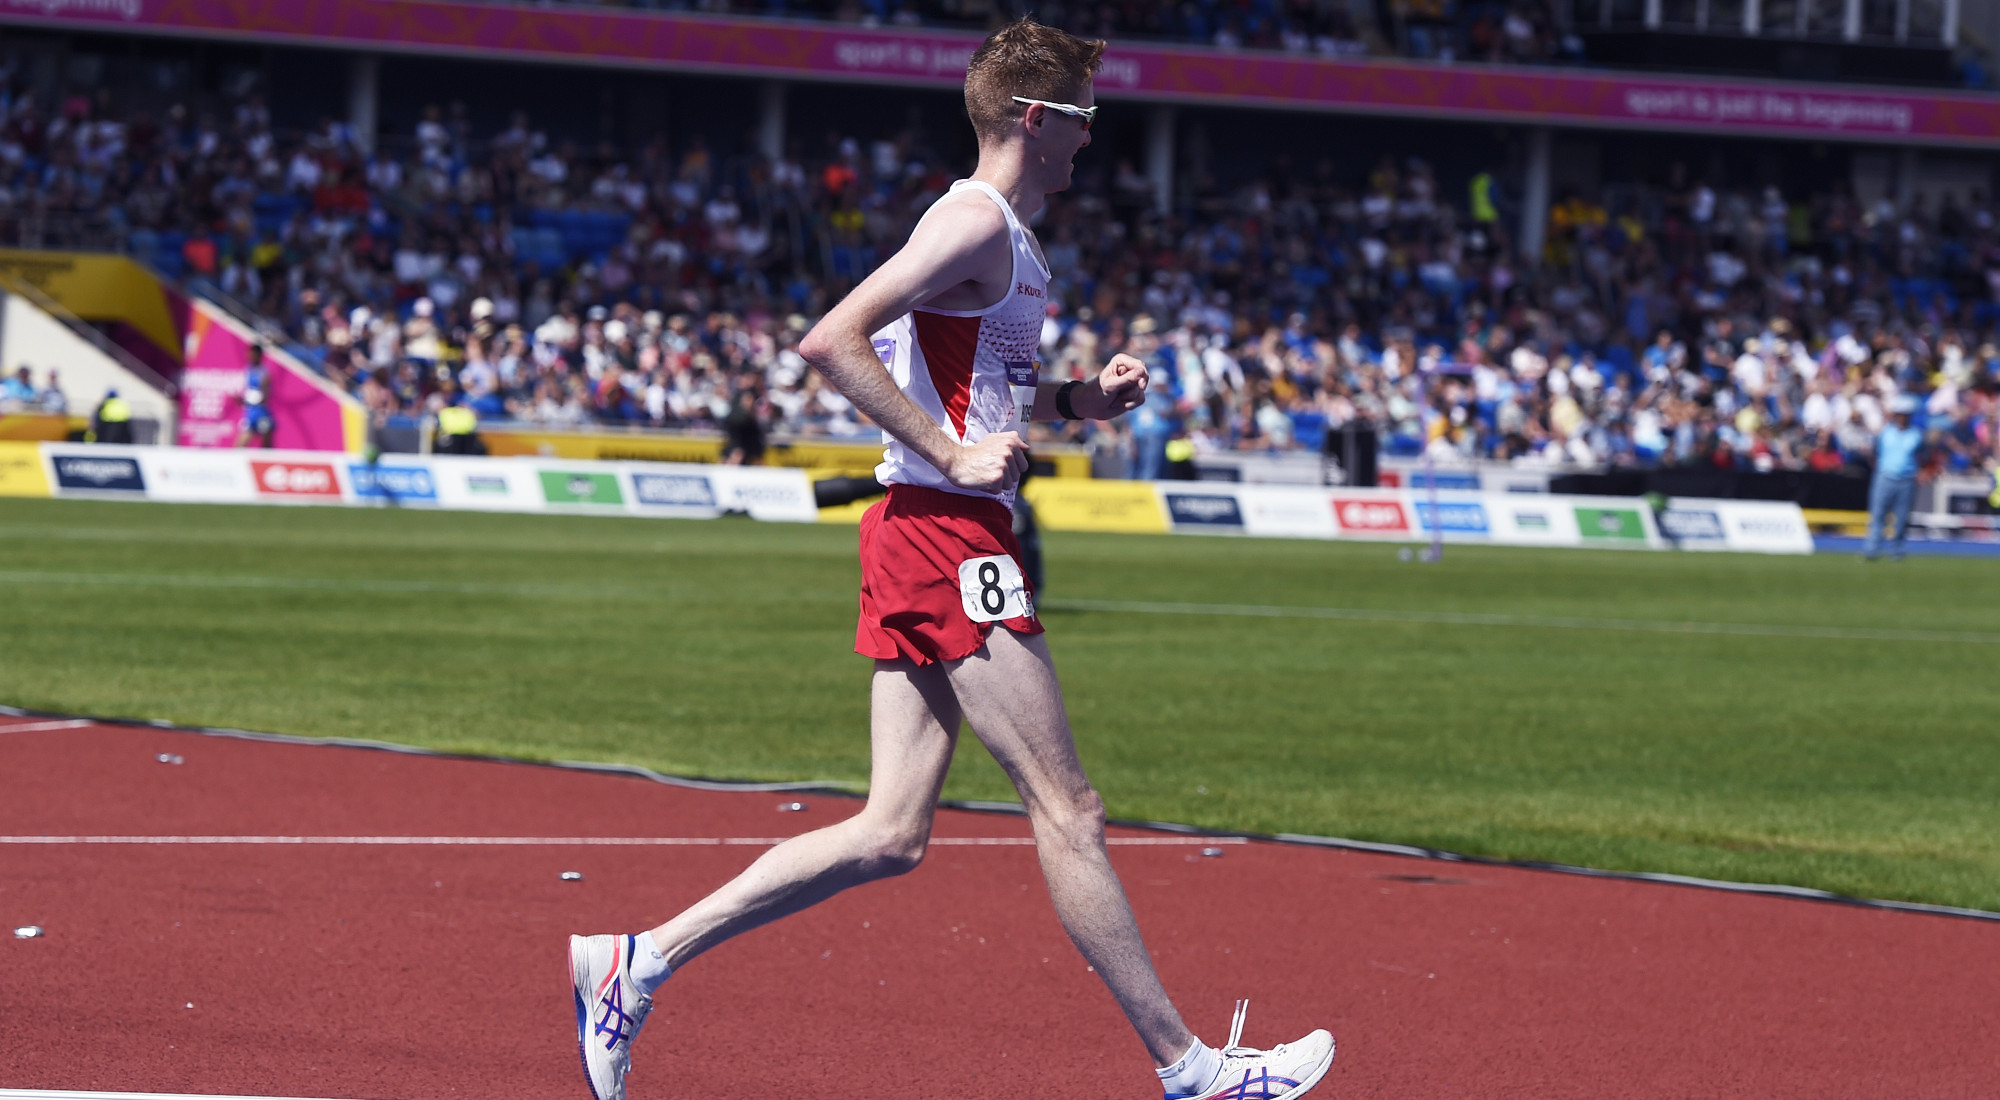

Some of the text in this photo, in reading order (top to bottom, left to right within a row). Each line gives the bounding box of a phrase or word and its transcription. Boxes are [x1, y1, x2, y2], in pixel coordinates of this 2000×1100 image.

[1626, 89, 1911, 131] sport is just the beginning
[1024, 284, 1045, 299] KUKR
[978, 561, 1005, 615] 8
